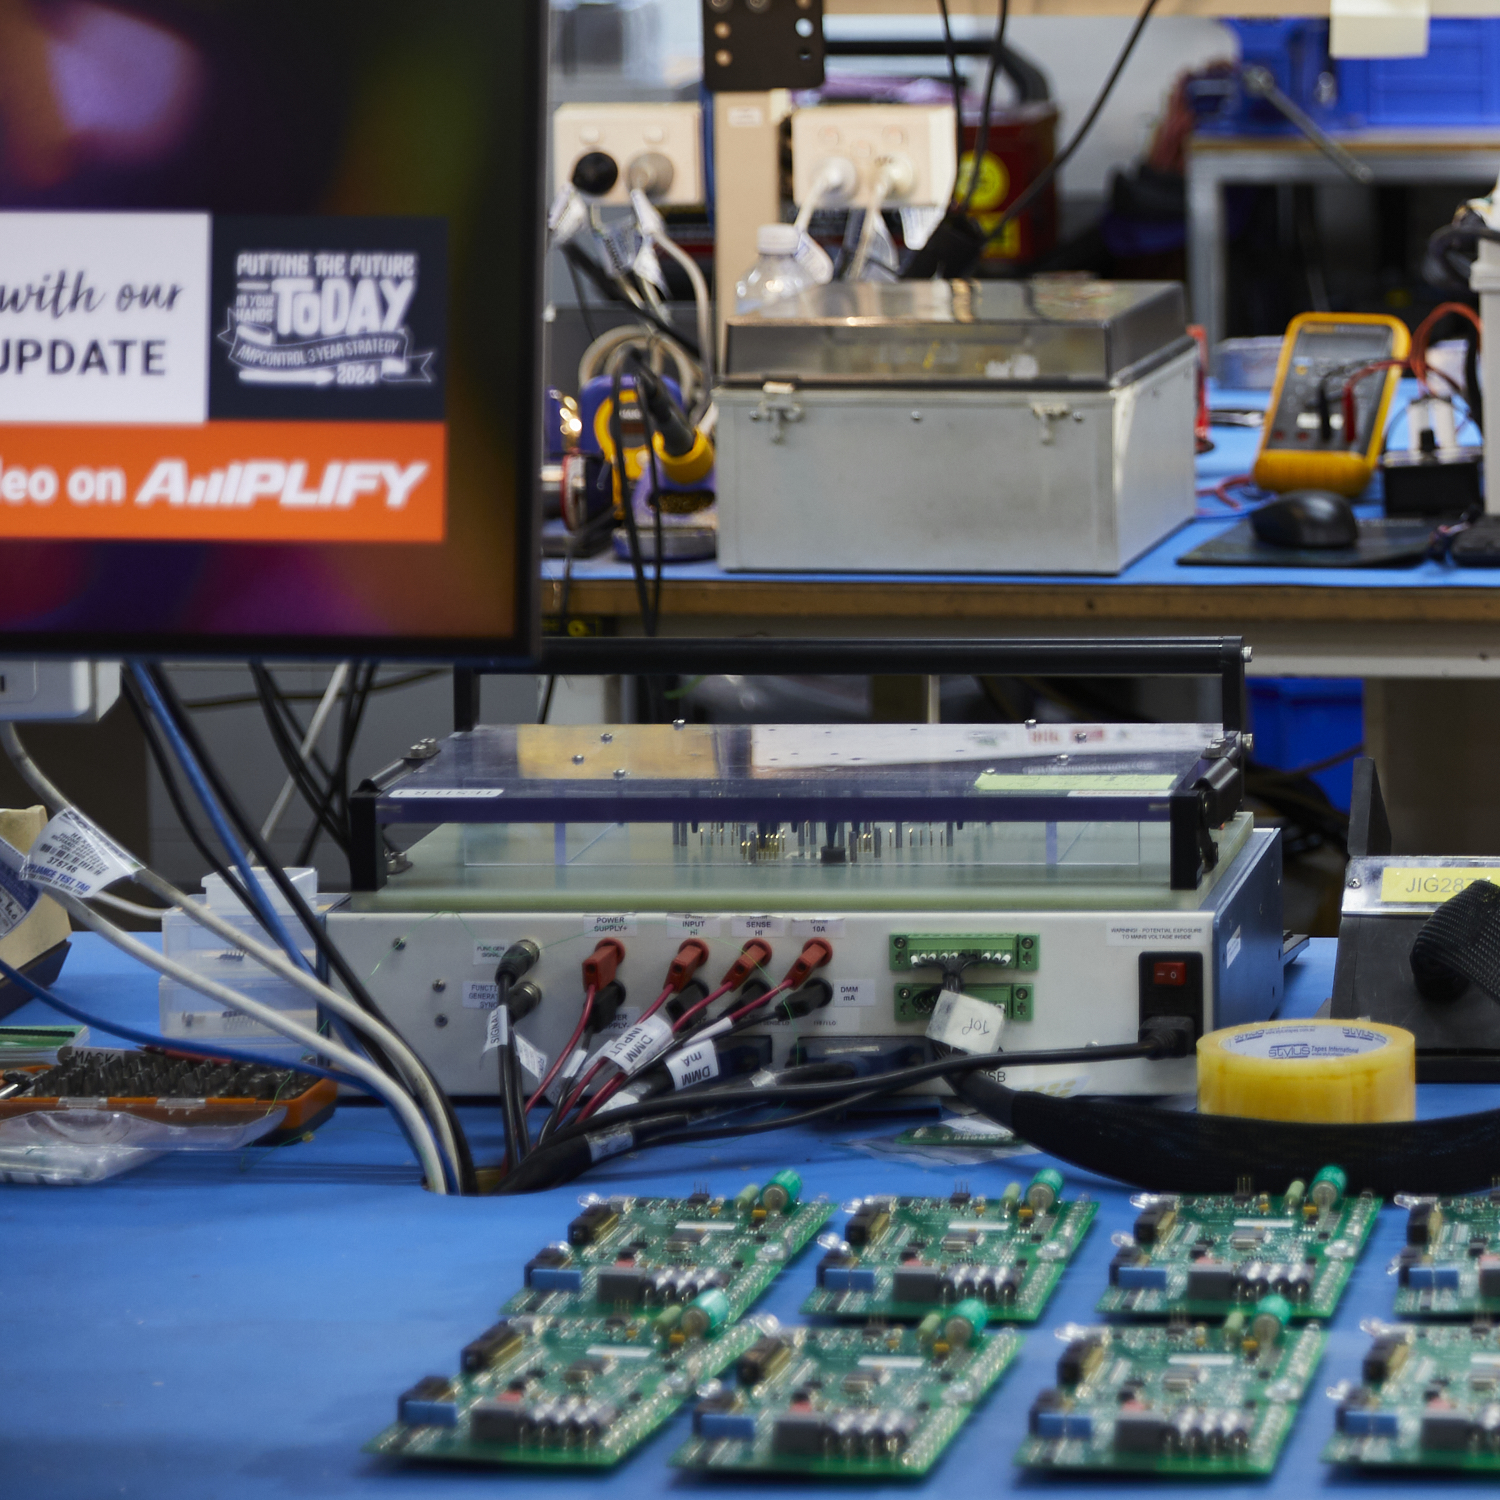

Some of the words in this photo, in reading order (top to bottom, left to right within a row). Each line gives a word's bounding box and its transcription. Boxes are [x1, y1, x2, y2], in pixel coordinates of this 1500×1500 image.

[237, 253, 309, 276] PUTTING
[314, 253, 346, 276] THE
[351, 254, 415, 276] FUTURE
[0, 270, 105, 319] with
[116, 283, 184, 312] our
[236, 295, 248, 309] IN
[250, 295, 274, 309] YOUR
[236, 309, 274, 323] HANDS
[237, 344, 307, 366] AMPCONTROL
[308, 349, 316, 362] 3
[316, 345, 345, 362] YEAR
[345, 339, 400, 358] STRATEGY
[337, 363, 376, 385] 2024
[0, 456, 58, 501] eo
[68, 467, 126, 501] on
[56, 873, 76, 886] TEST
[75, 881, 92, 892] TAG
[1406, 877, 1491, 893] JIG28
[490, 1011, 500, 1045] SIGNAL
[961, 1016, 990, 1036] TOP
[613, 1027, 644, 1057] INPUT
[626, 1034, 654, 1063] DMM
[1269, 1043, 1311, 1059] stylus
[1328, 1046, 1360, 1054] International
[681, 1052, 702, 1068] mA
[681, 1065, 711, 1086] DMM
